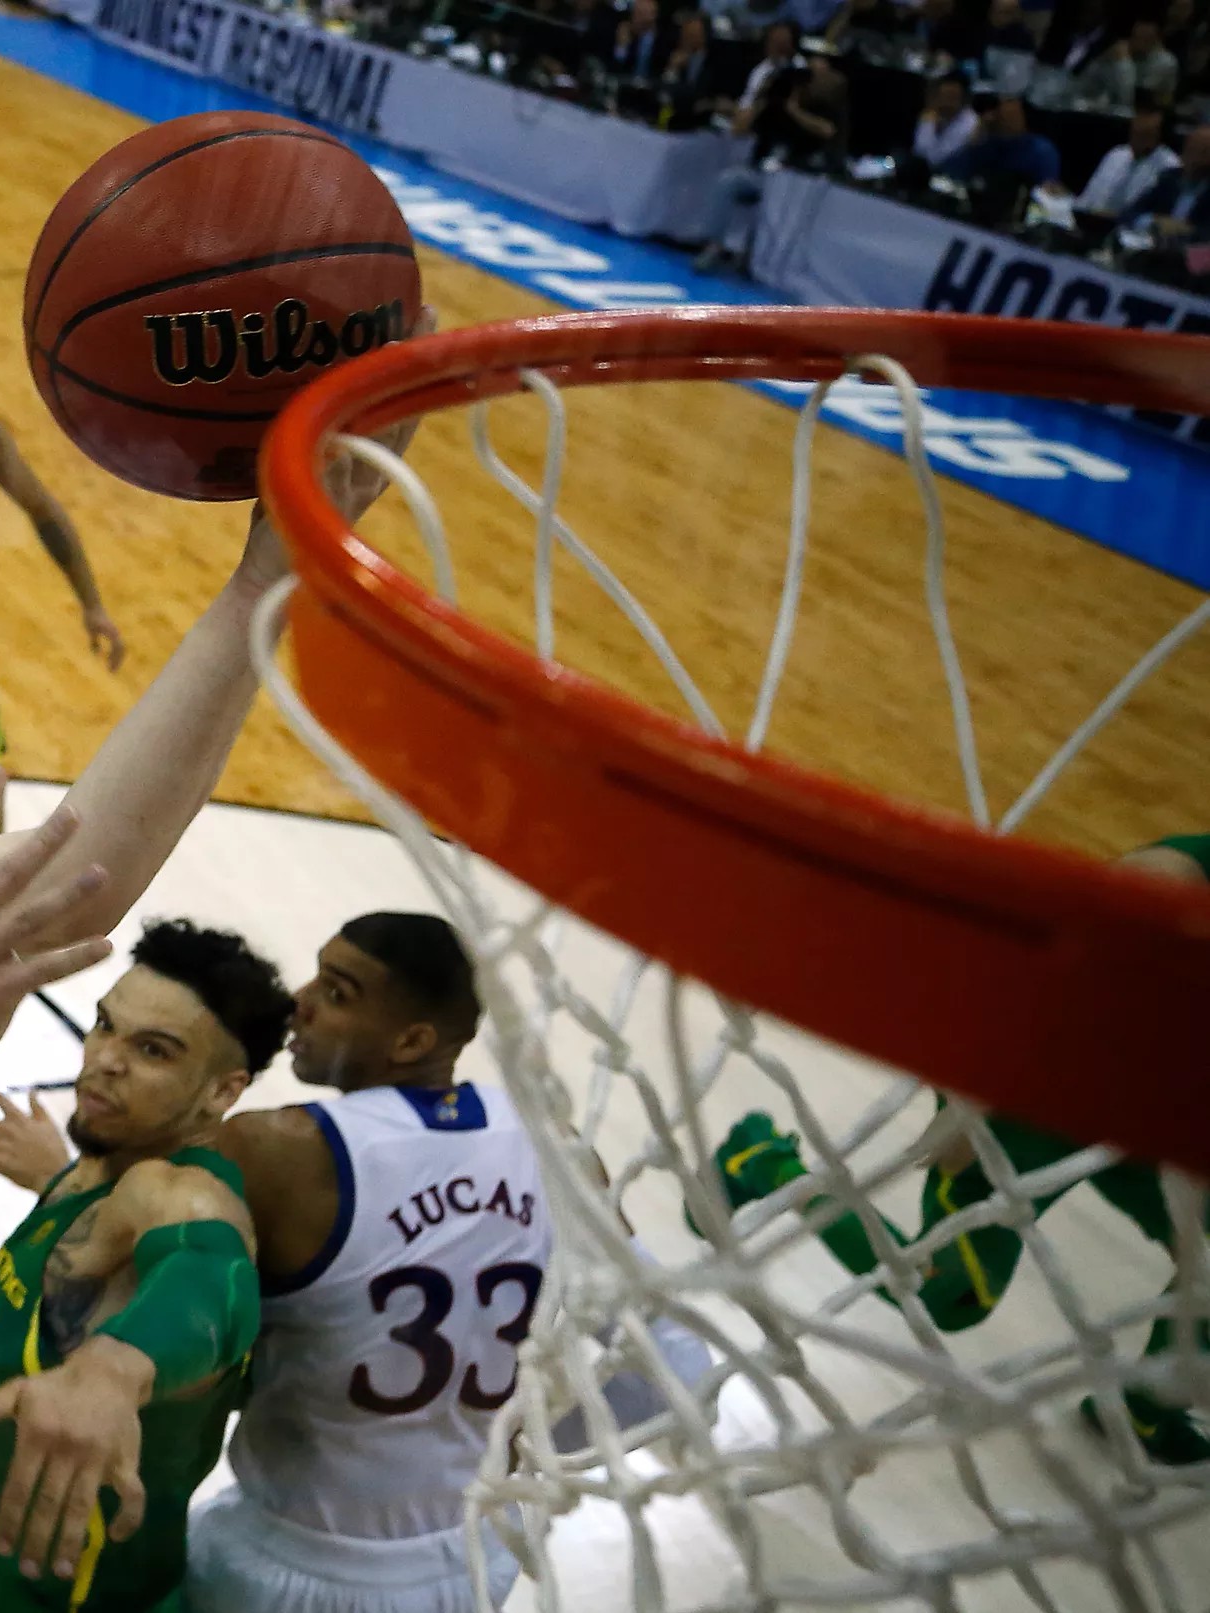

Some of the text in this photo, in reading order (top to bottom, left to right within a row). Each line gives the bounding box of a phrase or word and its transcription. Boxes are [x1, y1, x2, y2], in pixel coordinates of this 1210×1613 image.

[224, 11, 392, 132] REGIONAL
[143, 297, 404, 386] Wilson
[387, 1175, 535, 1244] LUCAS
[348, 1262, 543, 1415] 33
